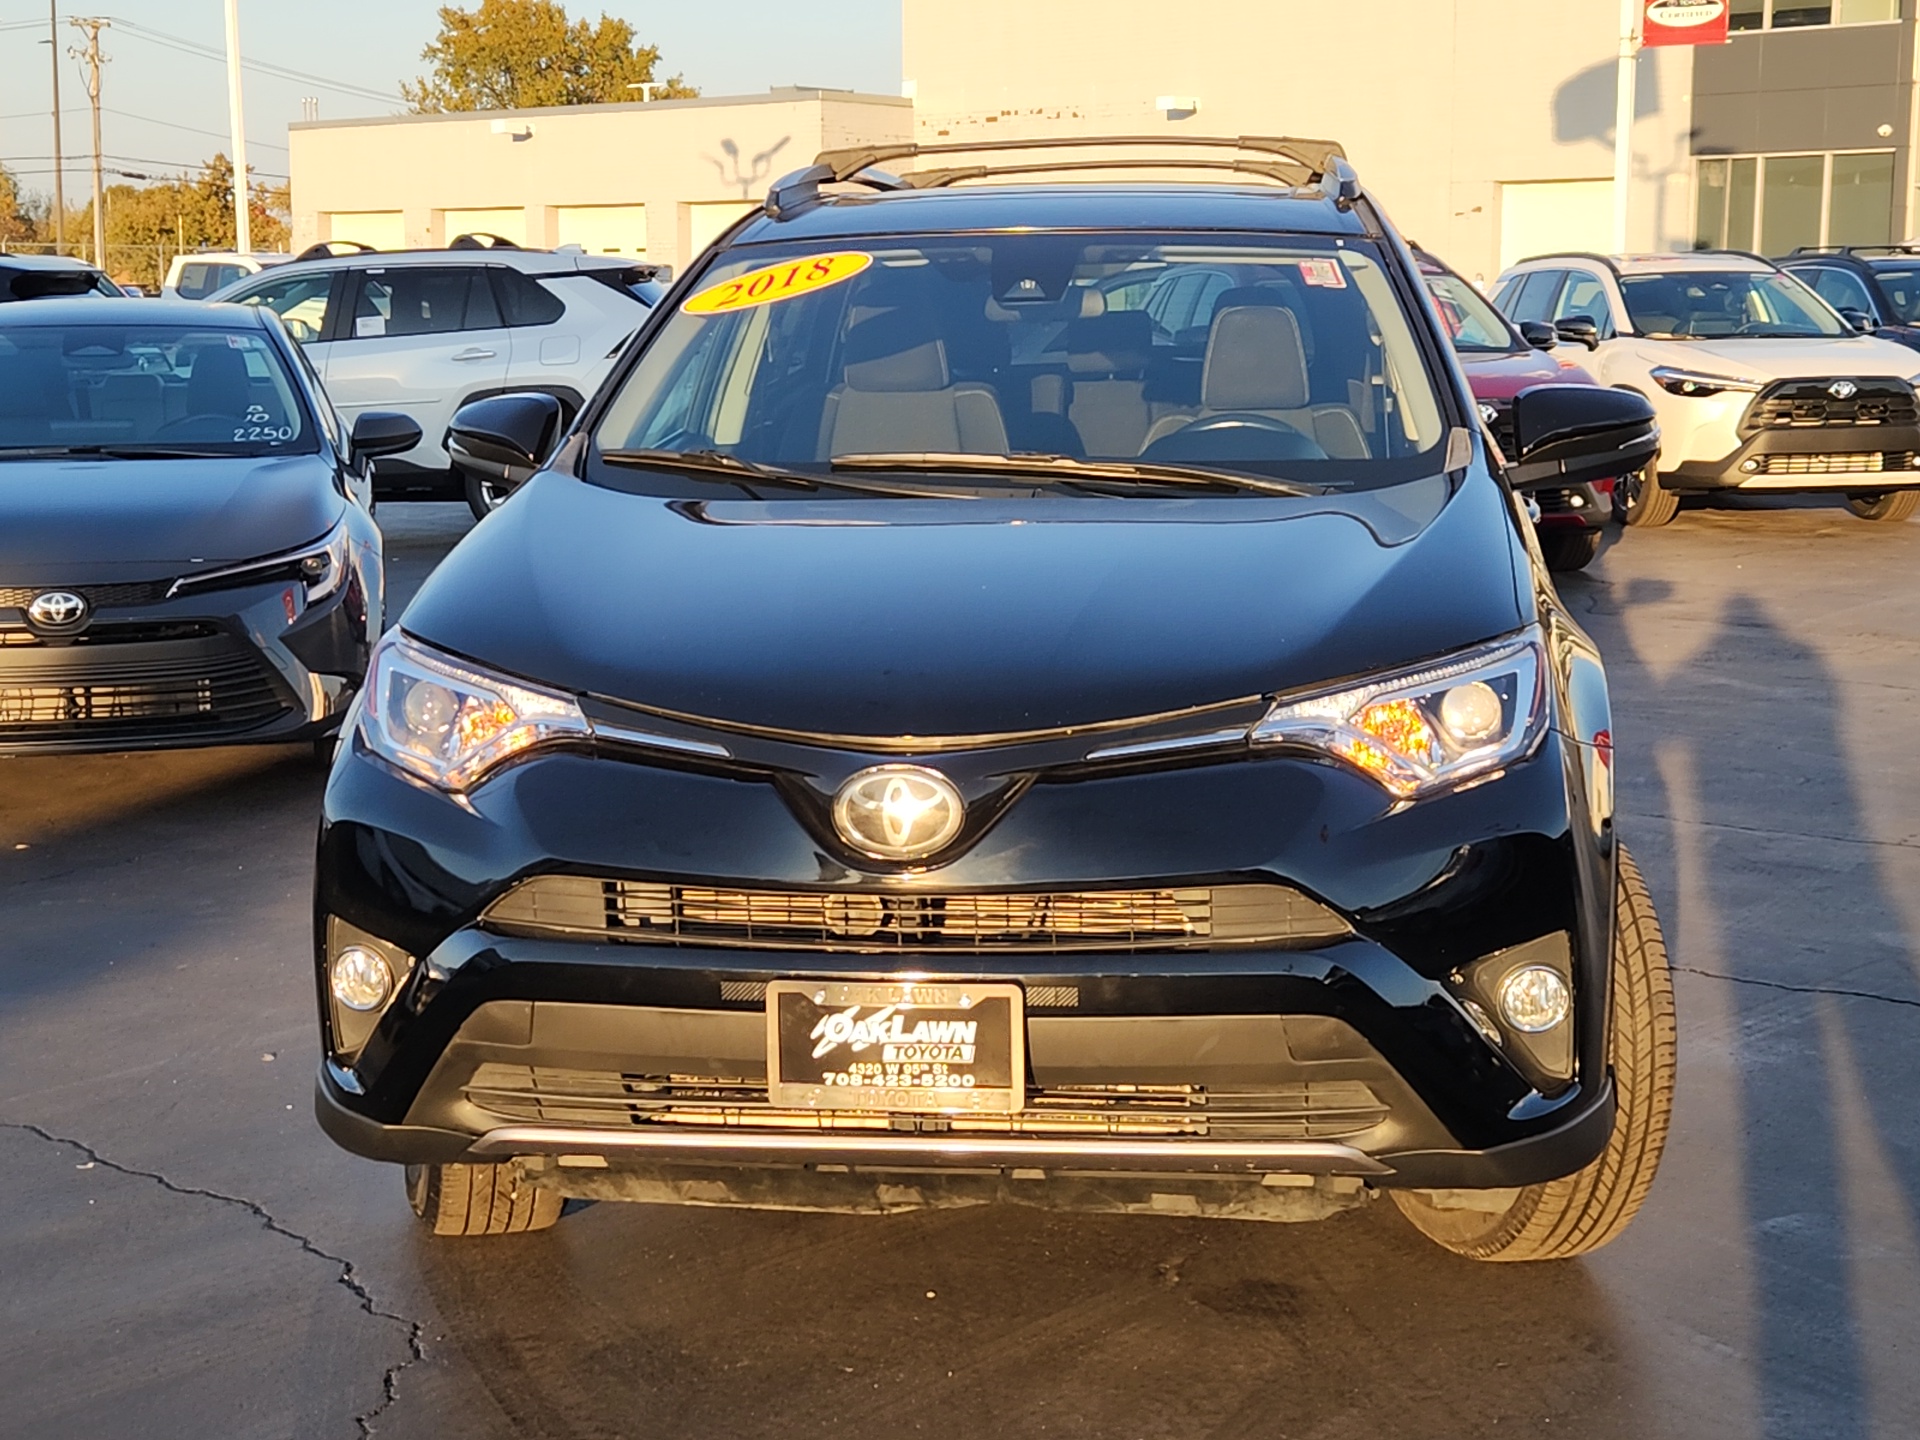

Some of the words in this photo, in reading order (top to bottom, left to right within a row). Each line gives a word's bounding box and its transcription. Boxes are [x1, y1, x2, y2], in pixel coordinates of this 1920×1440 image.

[714, 257, 835, 308] 2018
[232, 426, 292, 442] 2250
[892, 1046, 964, 1059] TOYOTA
[848, 1062, 882, 1075] 4320
[885, 1063, 900, 1075] W
[903, 1063, 930, 1075] 95th
[932, 1063, 949, 1075] St
[821, 1072, 976, 1087] 708-423-5200
